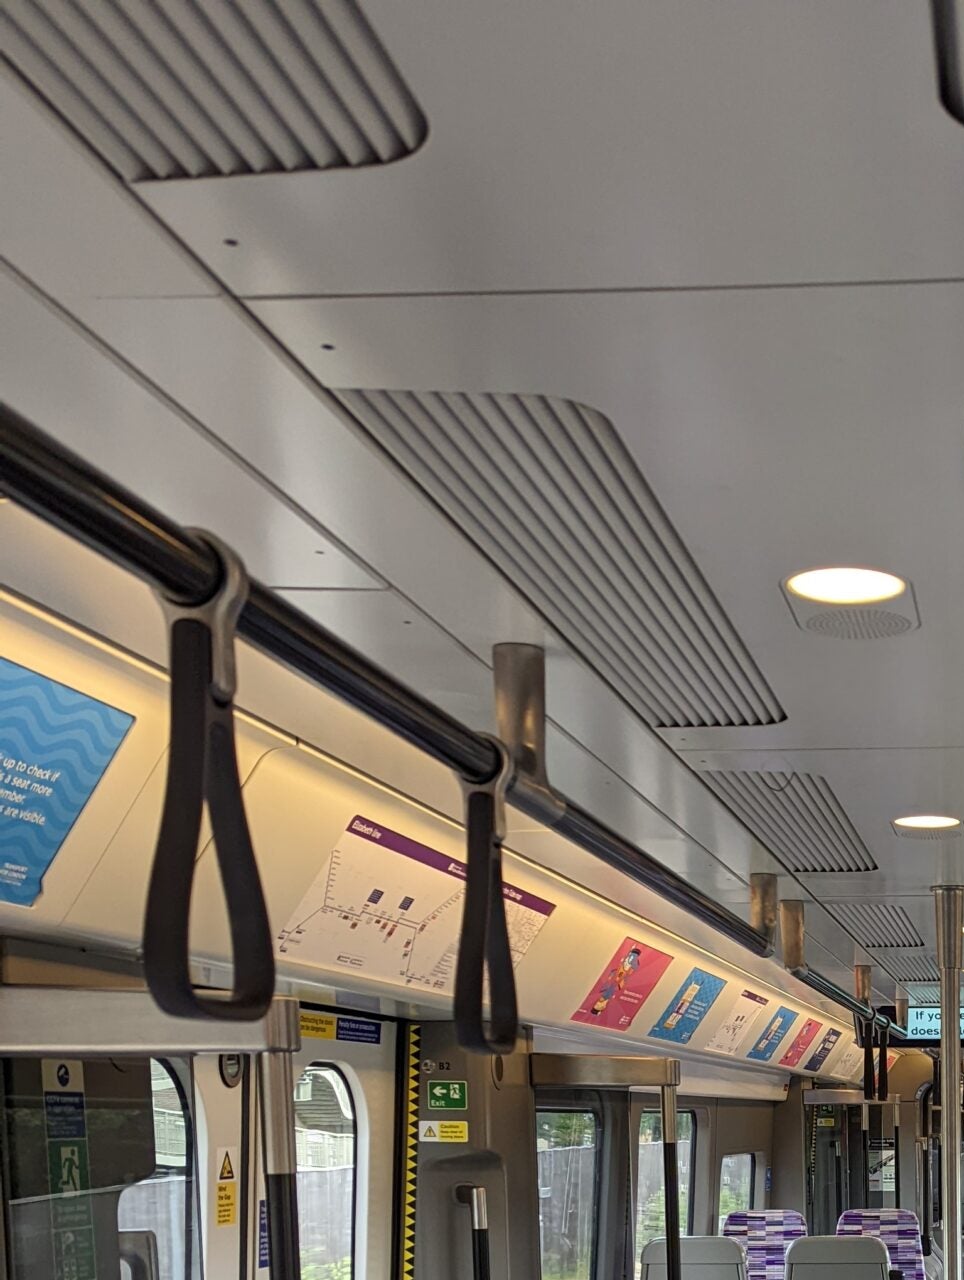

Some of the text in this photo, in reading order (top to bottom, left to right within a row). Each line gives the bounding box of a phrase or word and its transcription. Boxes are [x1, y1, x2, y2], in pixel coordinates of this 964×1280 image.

[3, 758, 62, 783] up to check if
[4, 774, 54, 797] a seat more
[4, 807, 19, 818] are
[915, 1011, 925, 1020] If
[928, 1013, 942, 1023] yo
[438, 1062, 451, 1071] B2
[430, 1099, 446, 1107] Exit
